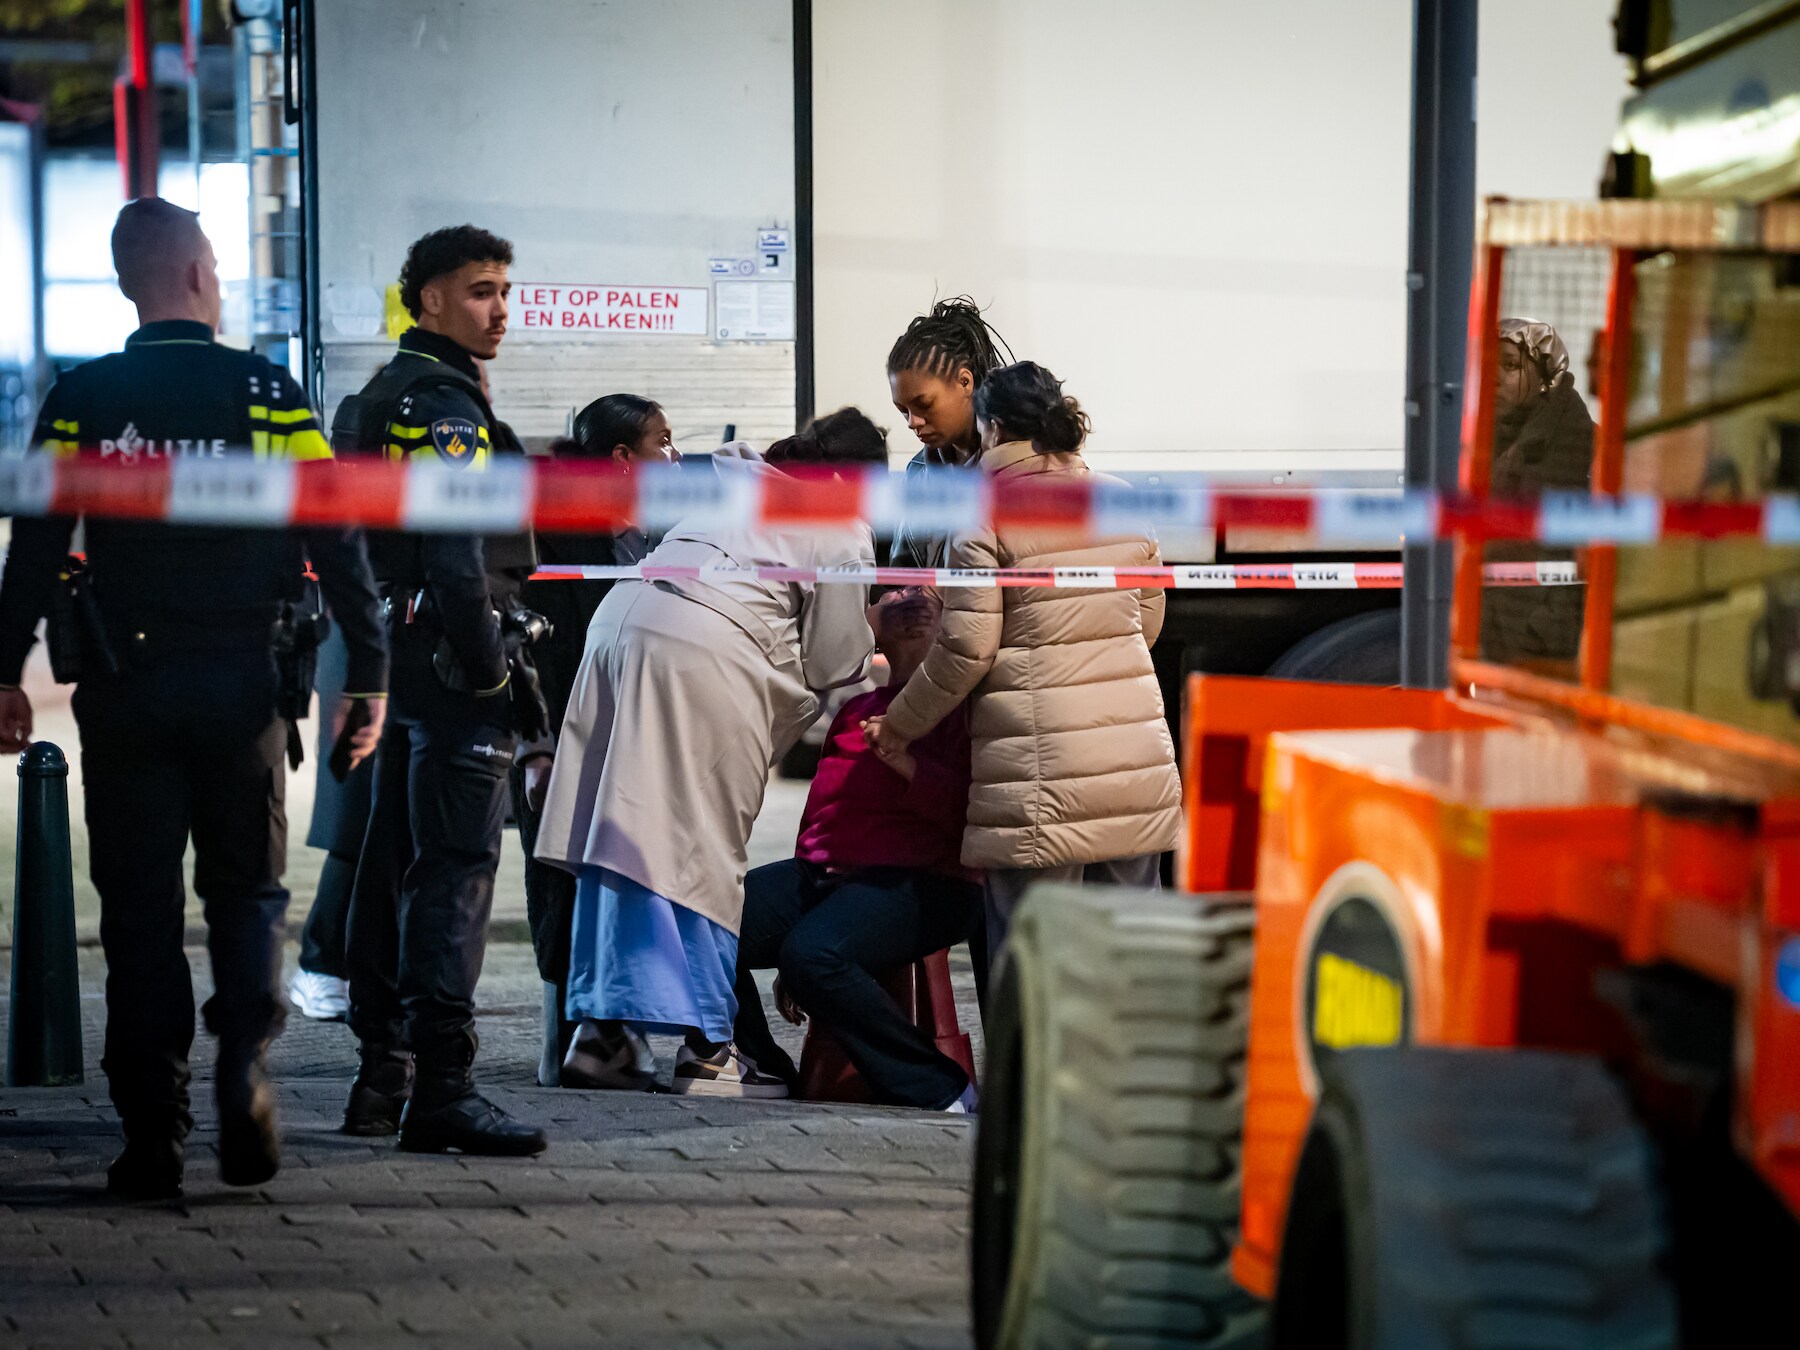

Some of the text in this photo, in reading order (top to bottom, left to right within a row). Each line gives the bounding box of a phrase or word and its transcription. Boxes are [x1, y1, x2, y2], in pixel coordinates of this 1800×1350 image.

[520, 288, 679, 308] LET OP PALEN
[524, 310, 674, 330] EN BALKEN!!!
